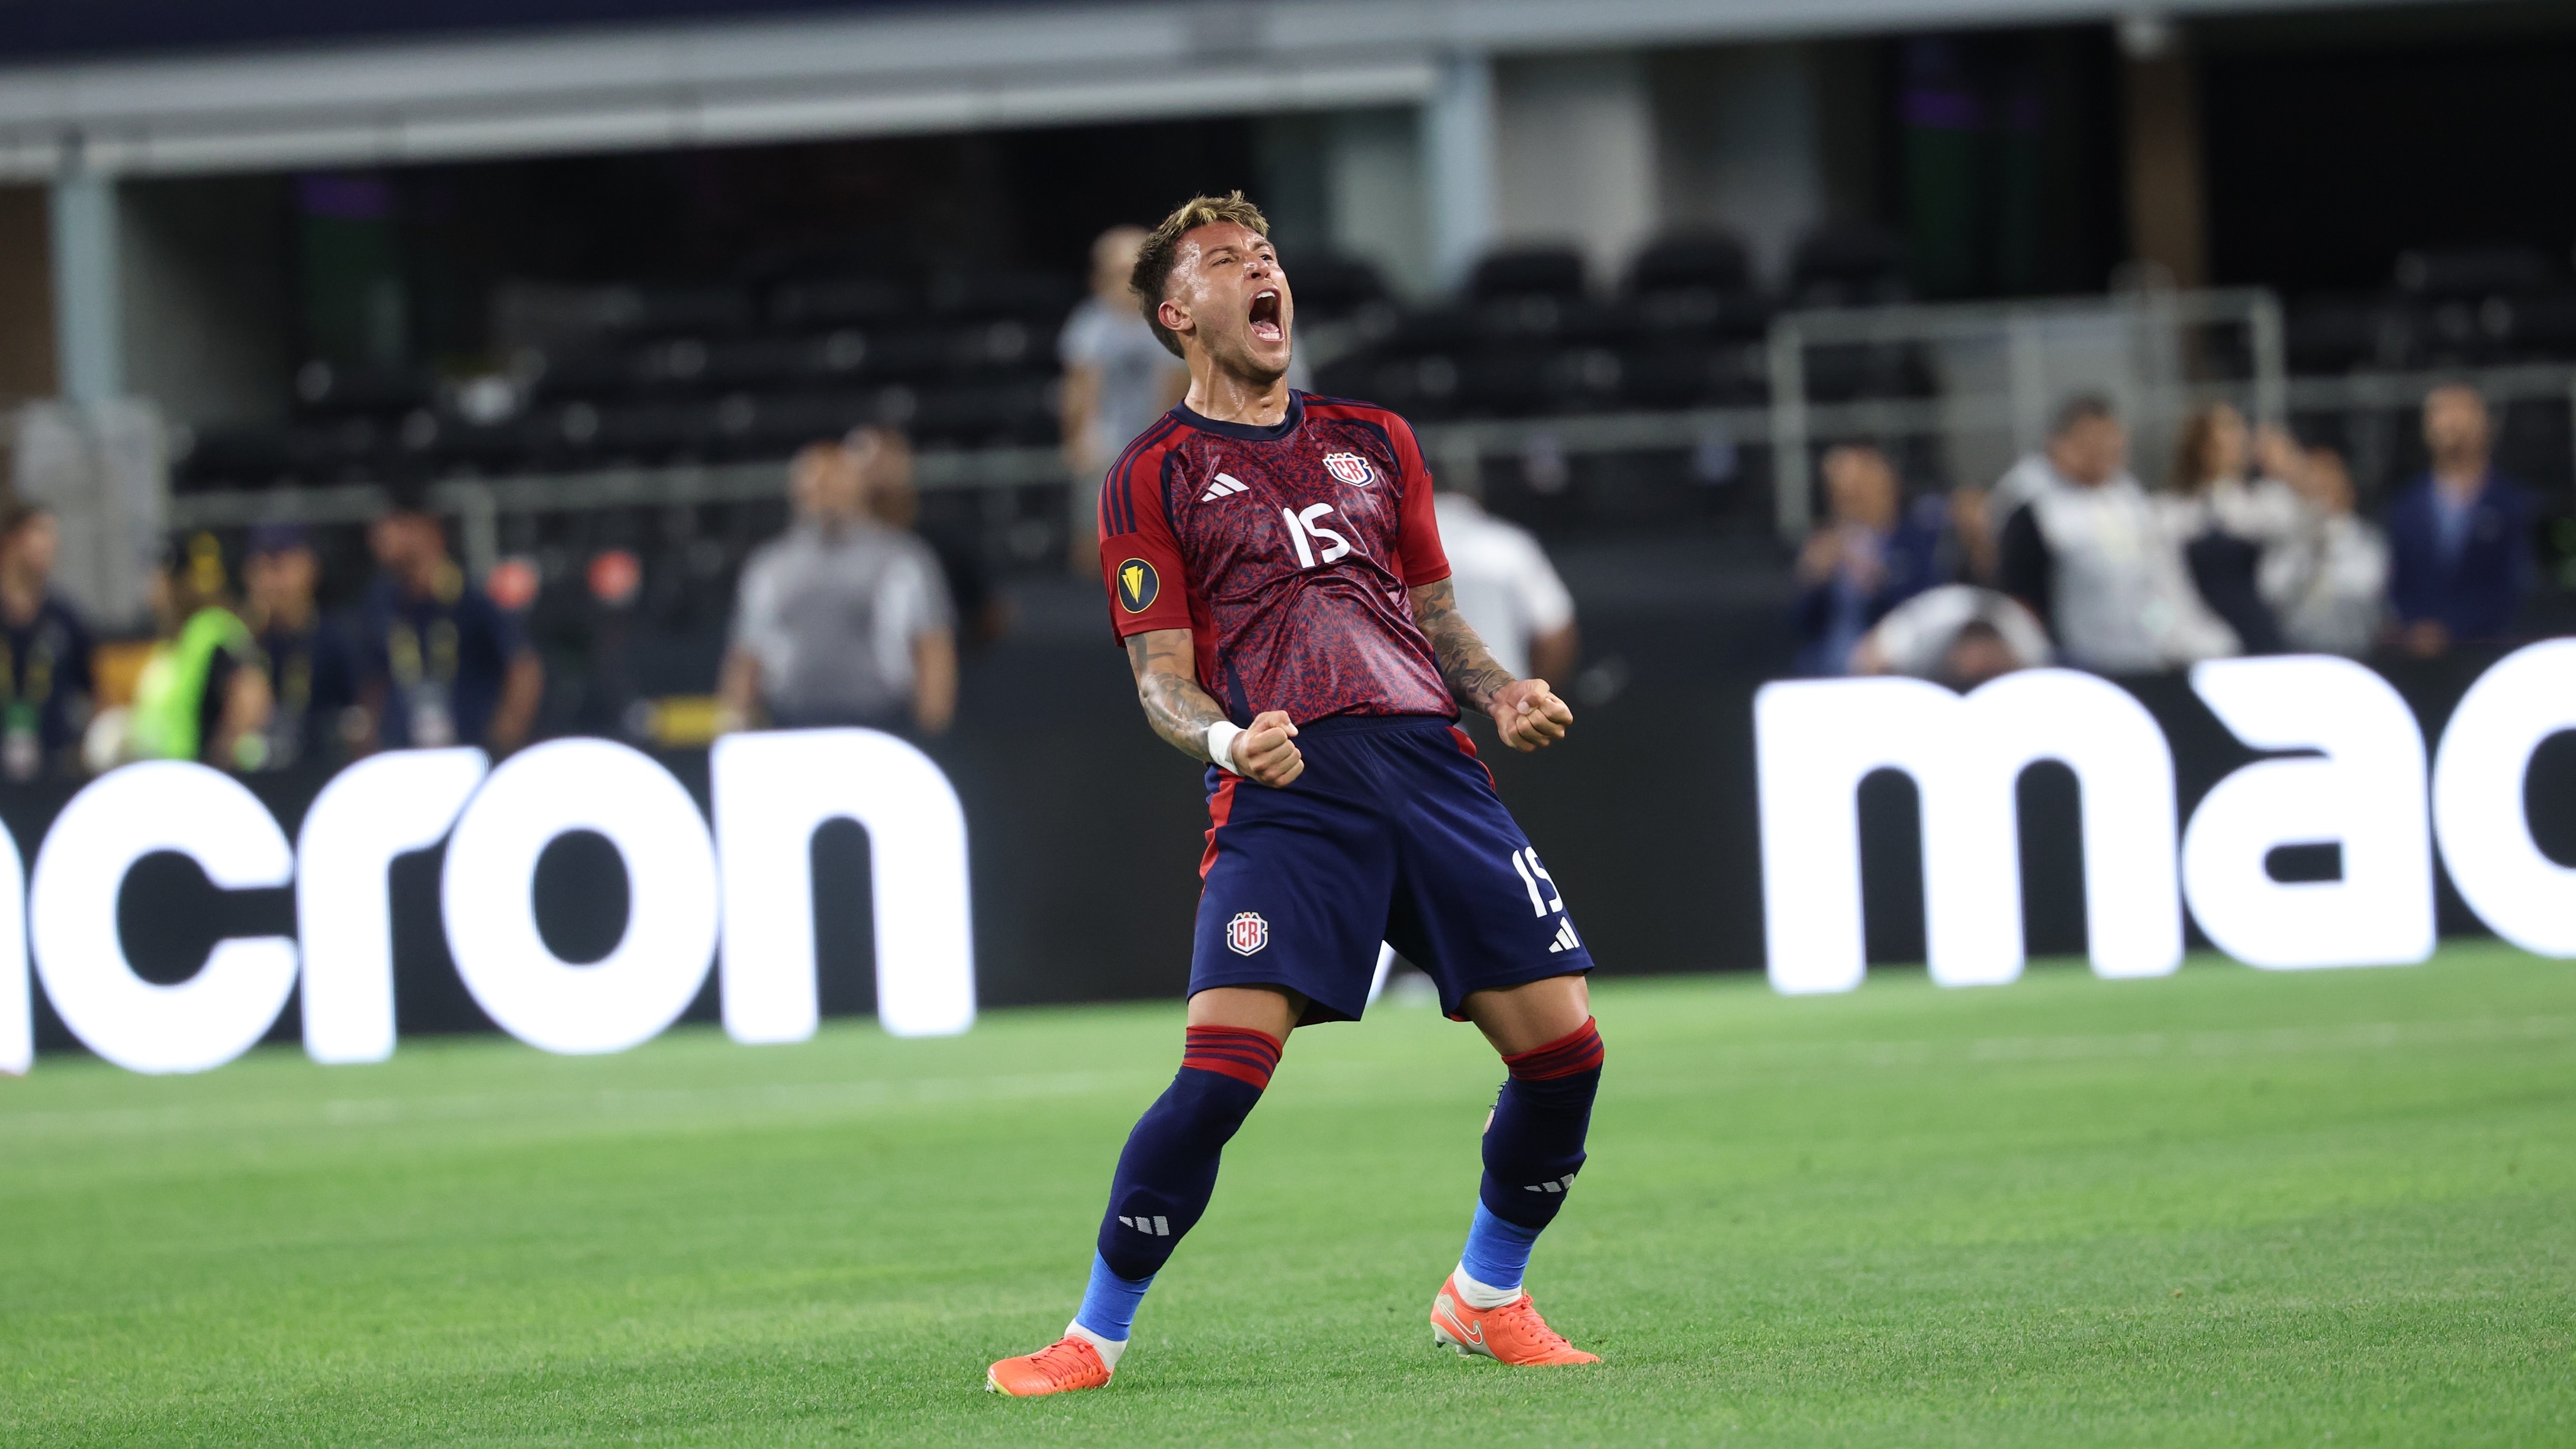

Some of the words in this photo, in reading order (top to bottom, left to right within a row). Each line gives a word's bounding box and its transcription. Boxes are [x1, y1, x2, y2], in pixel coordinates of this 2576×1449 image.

[1333, 460, 1364, 480] CR
[1283, 503, 1350, 568] 15
[0, 728, 976, 1075] cron
[1512, 846, 1563, 918] 15
[1237, 921, 1257, 947] CR
